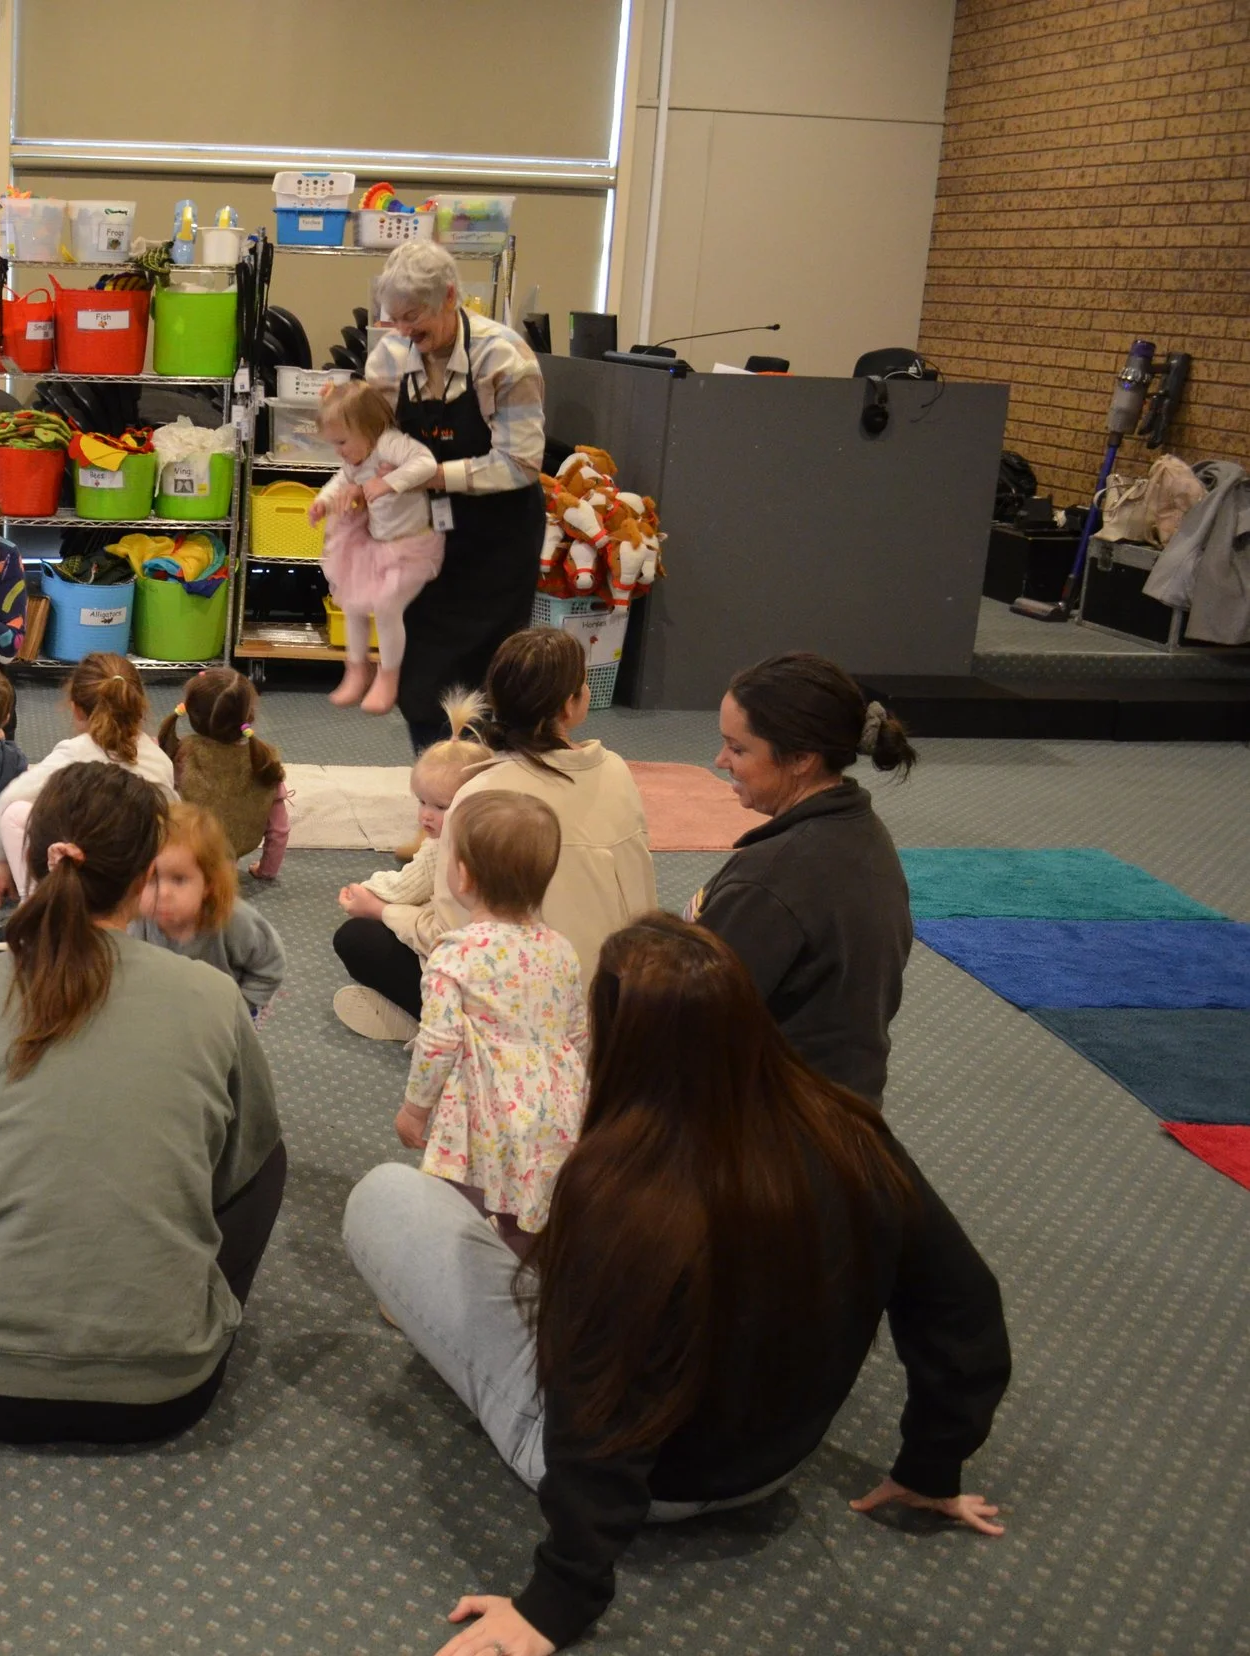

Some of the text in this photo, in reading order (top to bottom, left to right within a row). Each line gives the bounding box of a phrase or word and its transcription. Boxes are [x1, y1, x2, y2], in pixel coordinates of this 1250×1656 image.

[107, 228, 125, 239] Frogs
[95, 311, 111, 320] Fish
[90, 610, 122, 619] Alligators
